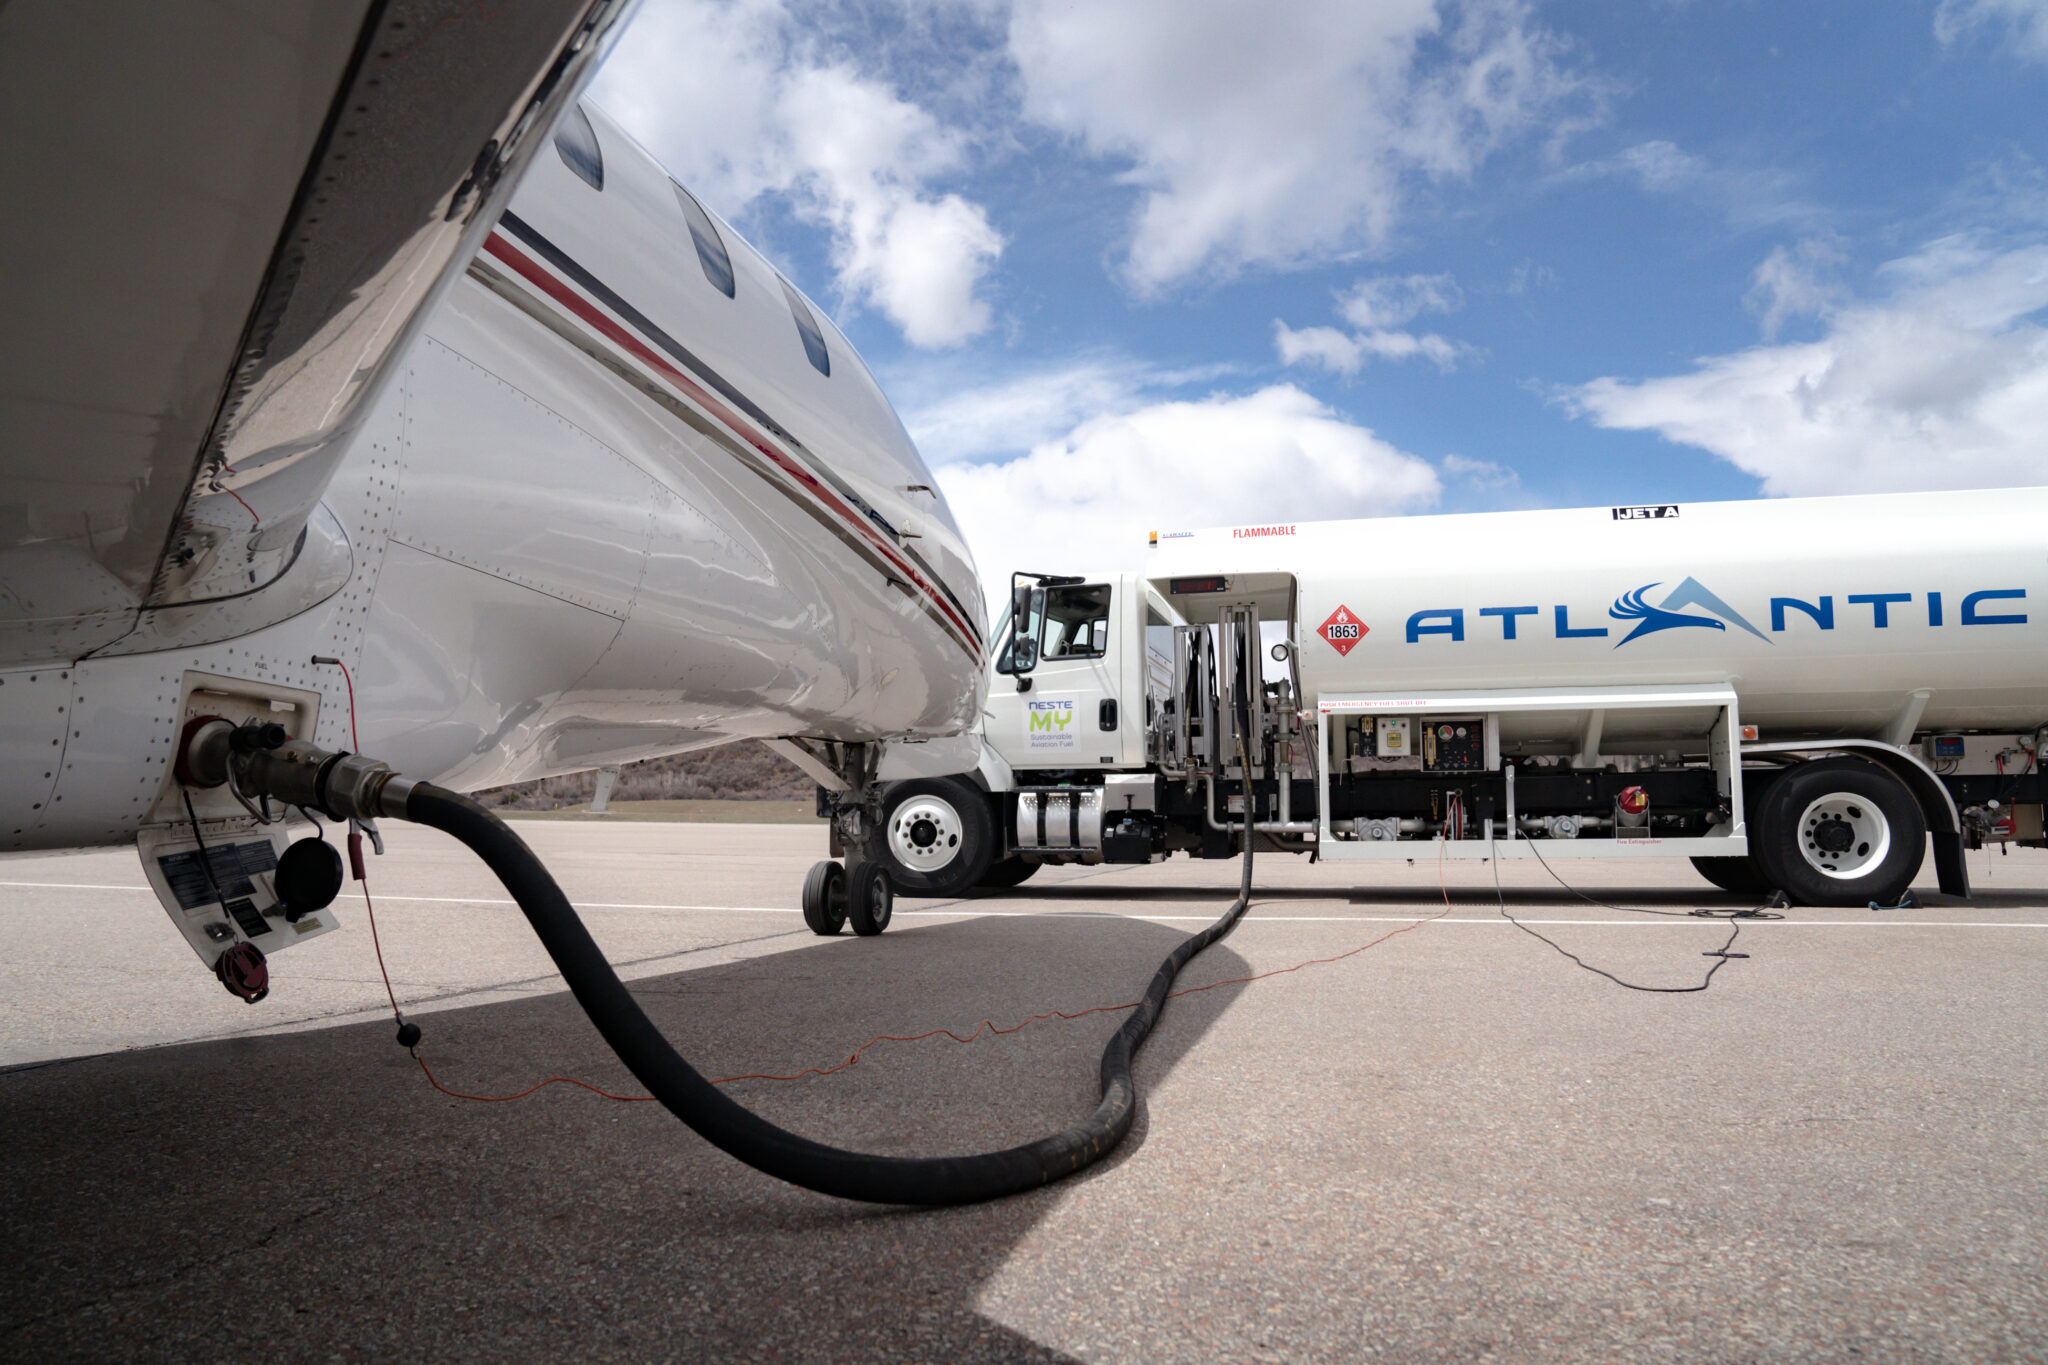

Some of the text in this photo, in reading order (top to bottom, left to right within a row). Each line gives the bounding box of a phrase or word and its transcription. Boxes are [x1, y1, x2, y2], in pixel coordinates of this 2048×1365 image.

[1620, 506, 1679, 519] JET A
[1233, 526, 1296, 539] FLAMMABLE
[1329, 625, 1358, 638] 1863
[1029, 700, 1073, 710] NESTE
[1030, 710, 1073, 732] MY
[1059, 740, 1074, 748] Fuel
